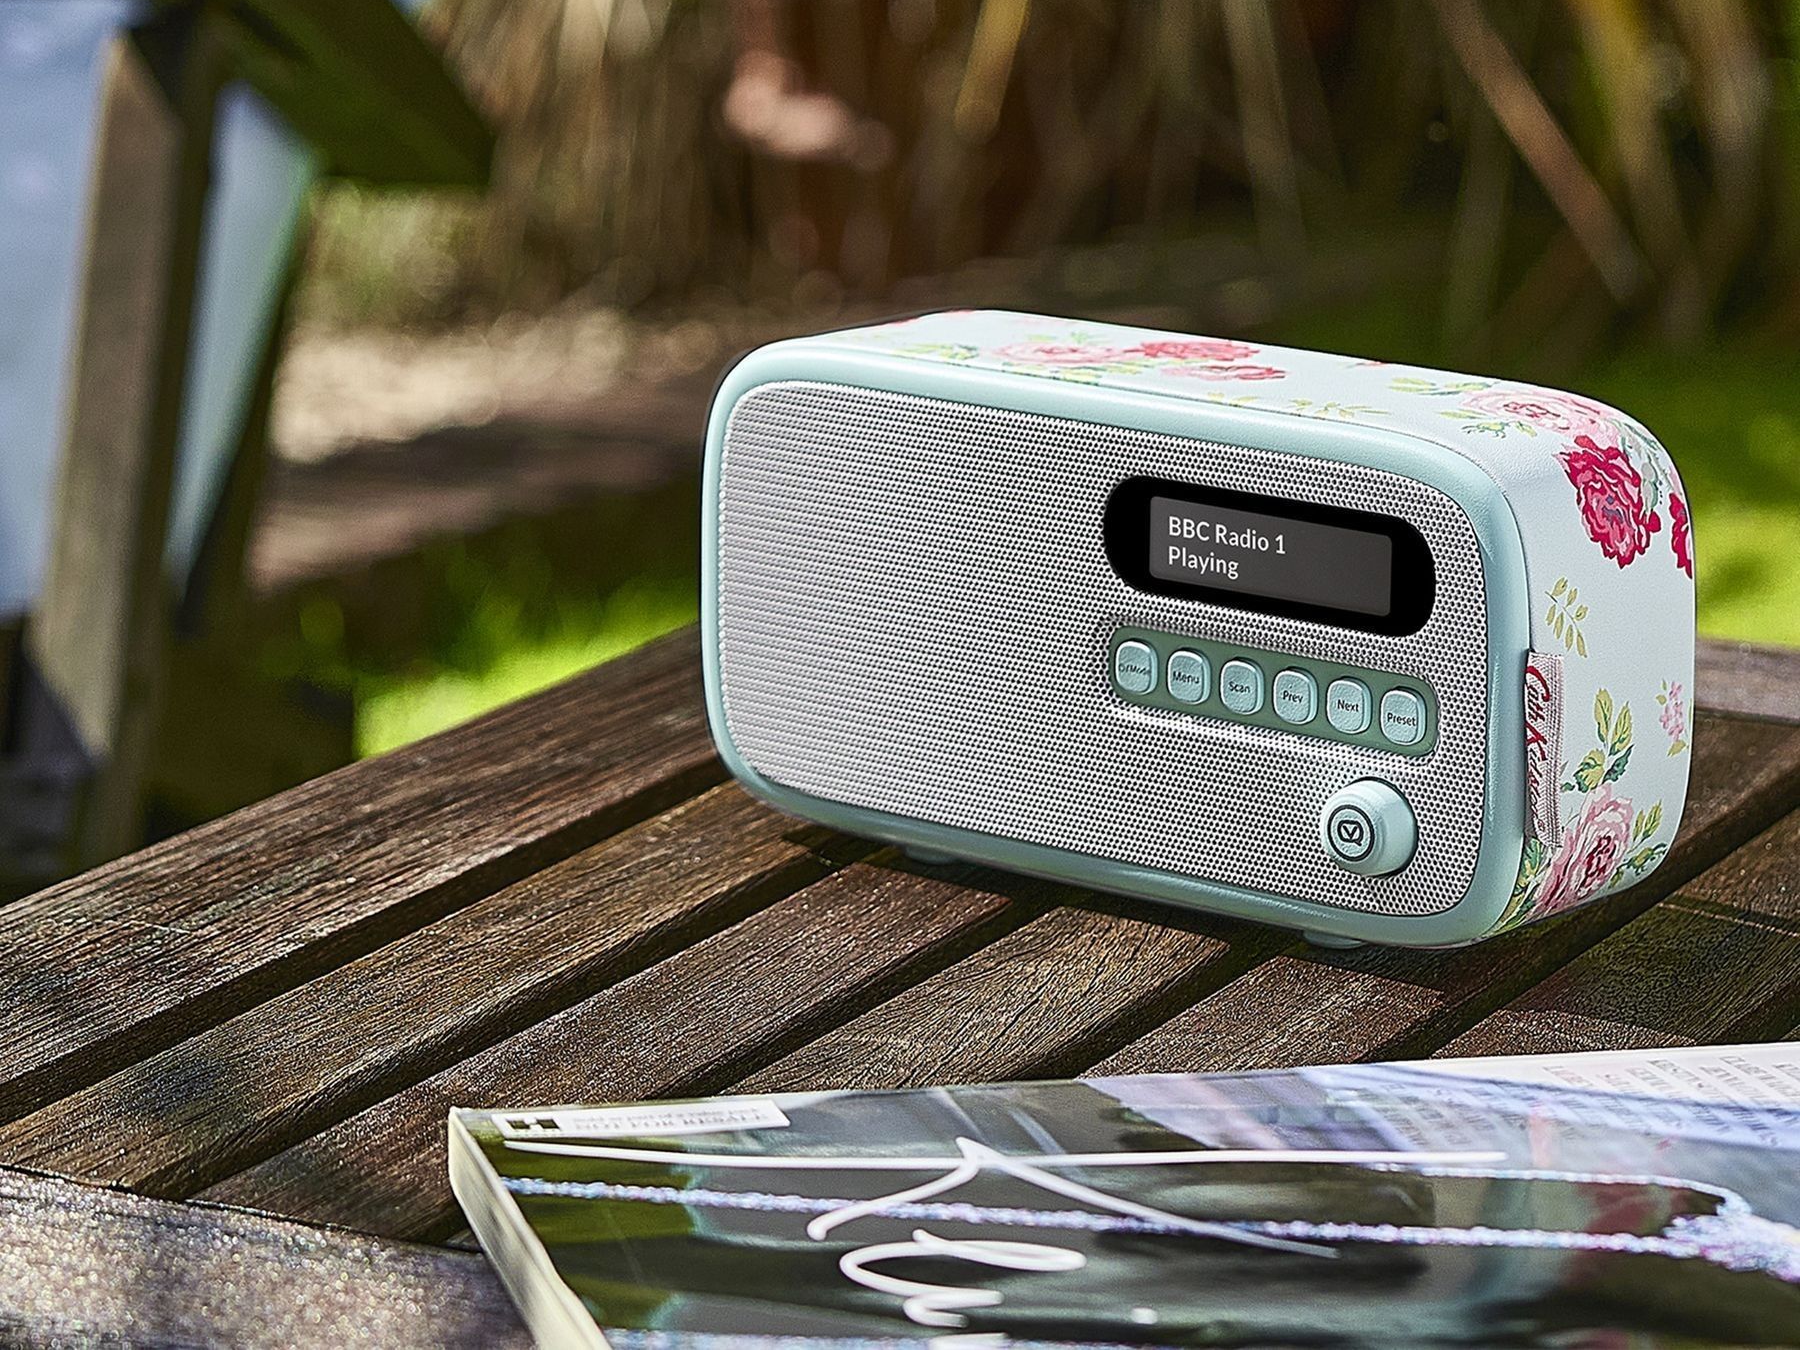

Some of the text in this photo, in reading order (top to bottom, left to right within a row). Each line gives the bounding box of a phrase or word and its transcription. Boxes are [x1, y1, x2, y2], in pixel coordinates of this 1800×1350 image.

[1168, 516, 1286, 554] BBC Radio 1
[1168, 545, 1240, 581] Playing
[1172, 669, 1200, 685] Menu
[1228, 680, 1250, 694] Scan
[1282, 690, 1304, 704] Prev
[1337, 699, 1360, 713] Next
[1386, 711, 1418, 727] Preset
